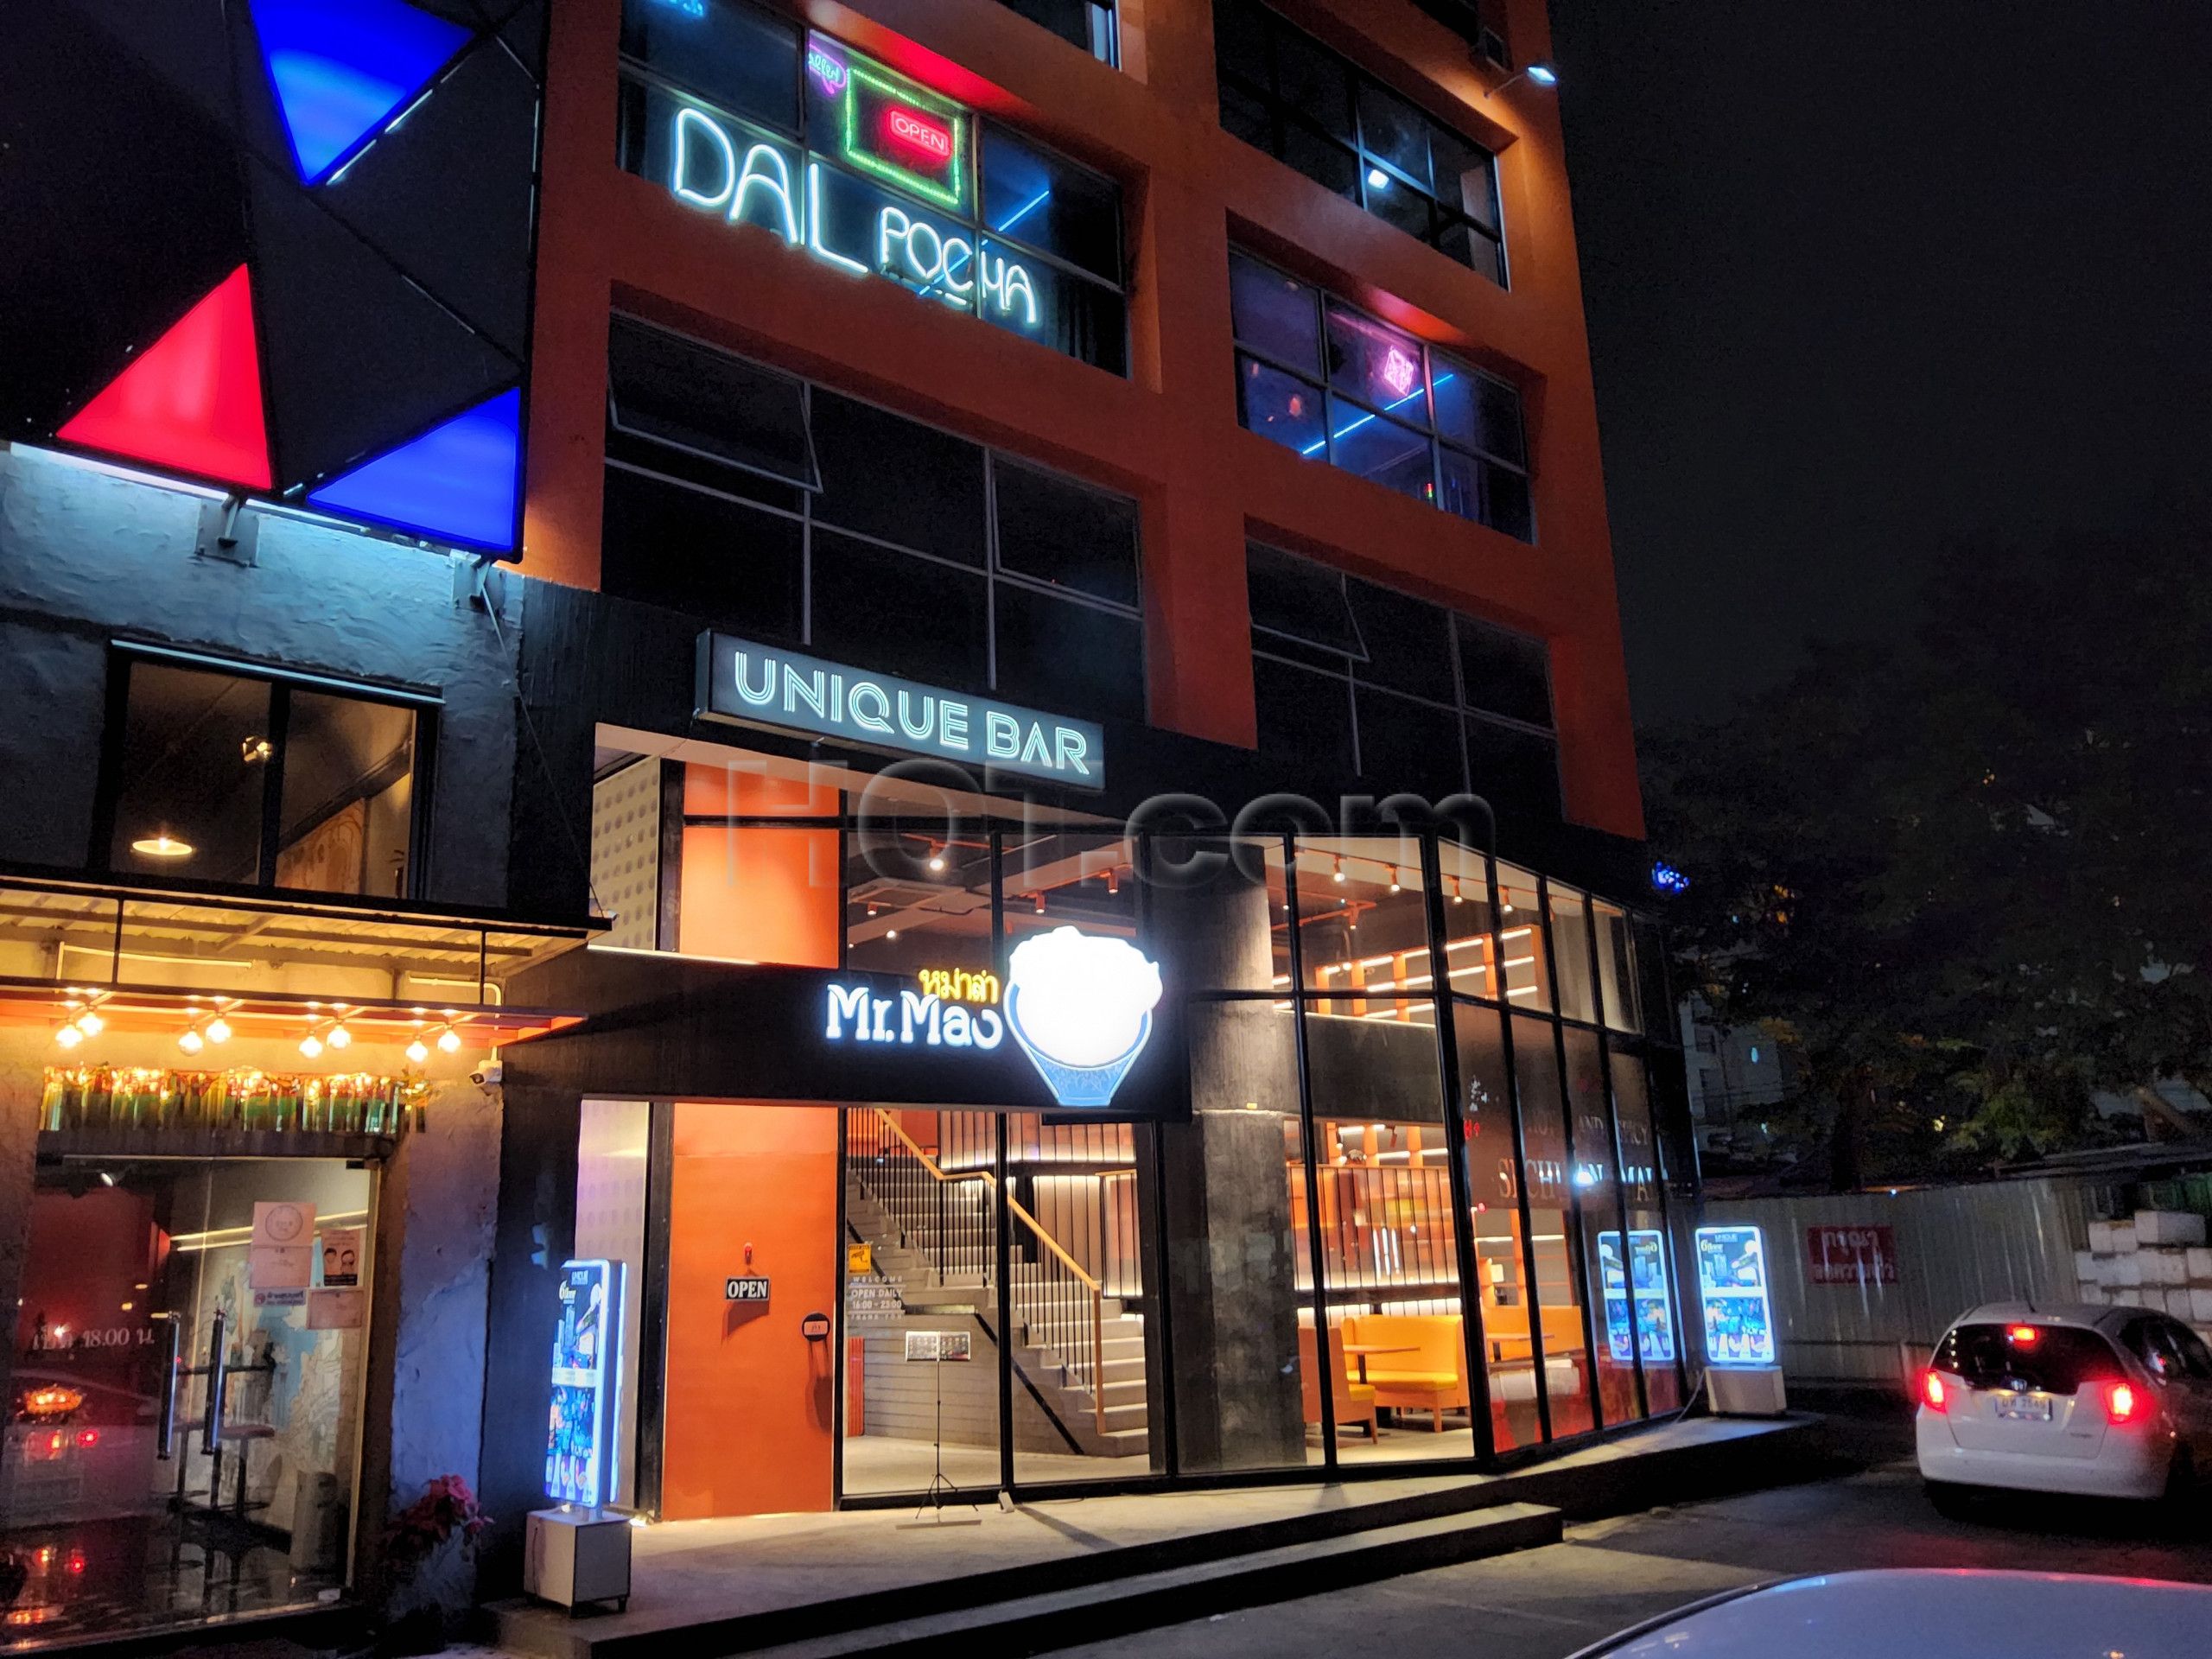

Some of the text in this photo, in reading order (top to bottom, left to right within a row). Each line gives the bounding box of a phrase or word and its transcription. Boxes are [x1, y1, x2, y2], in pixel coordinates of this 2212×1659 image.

[894, 118, 944, 151] OPEN
[673, 108, 1037, 323] DAL POCHA
[734, 652, 1090, 775] UNIQUE BAR
[728, 1281, 767, 1299] OPEN
[851, 1288, 903, 1299] OPEN DAILY
